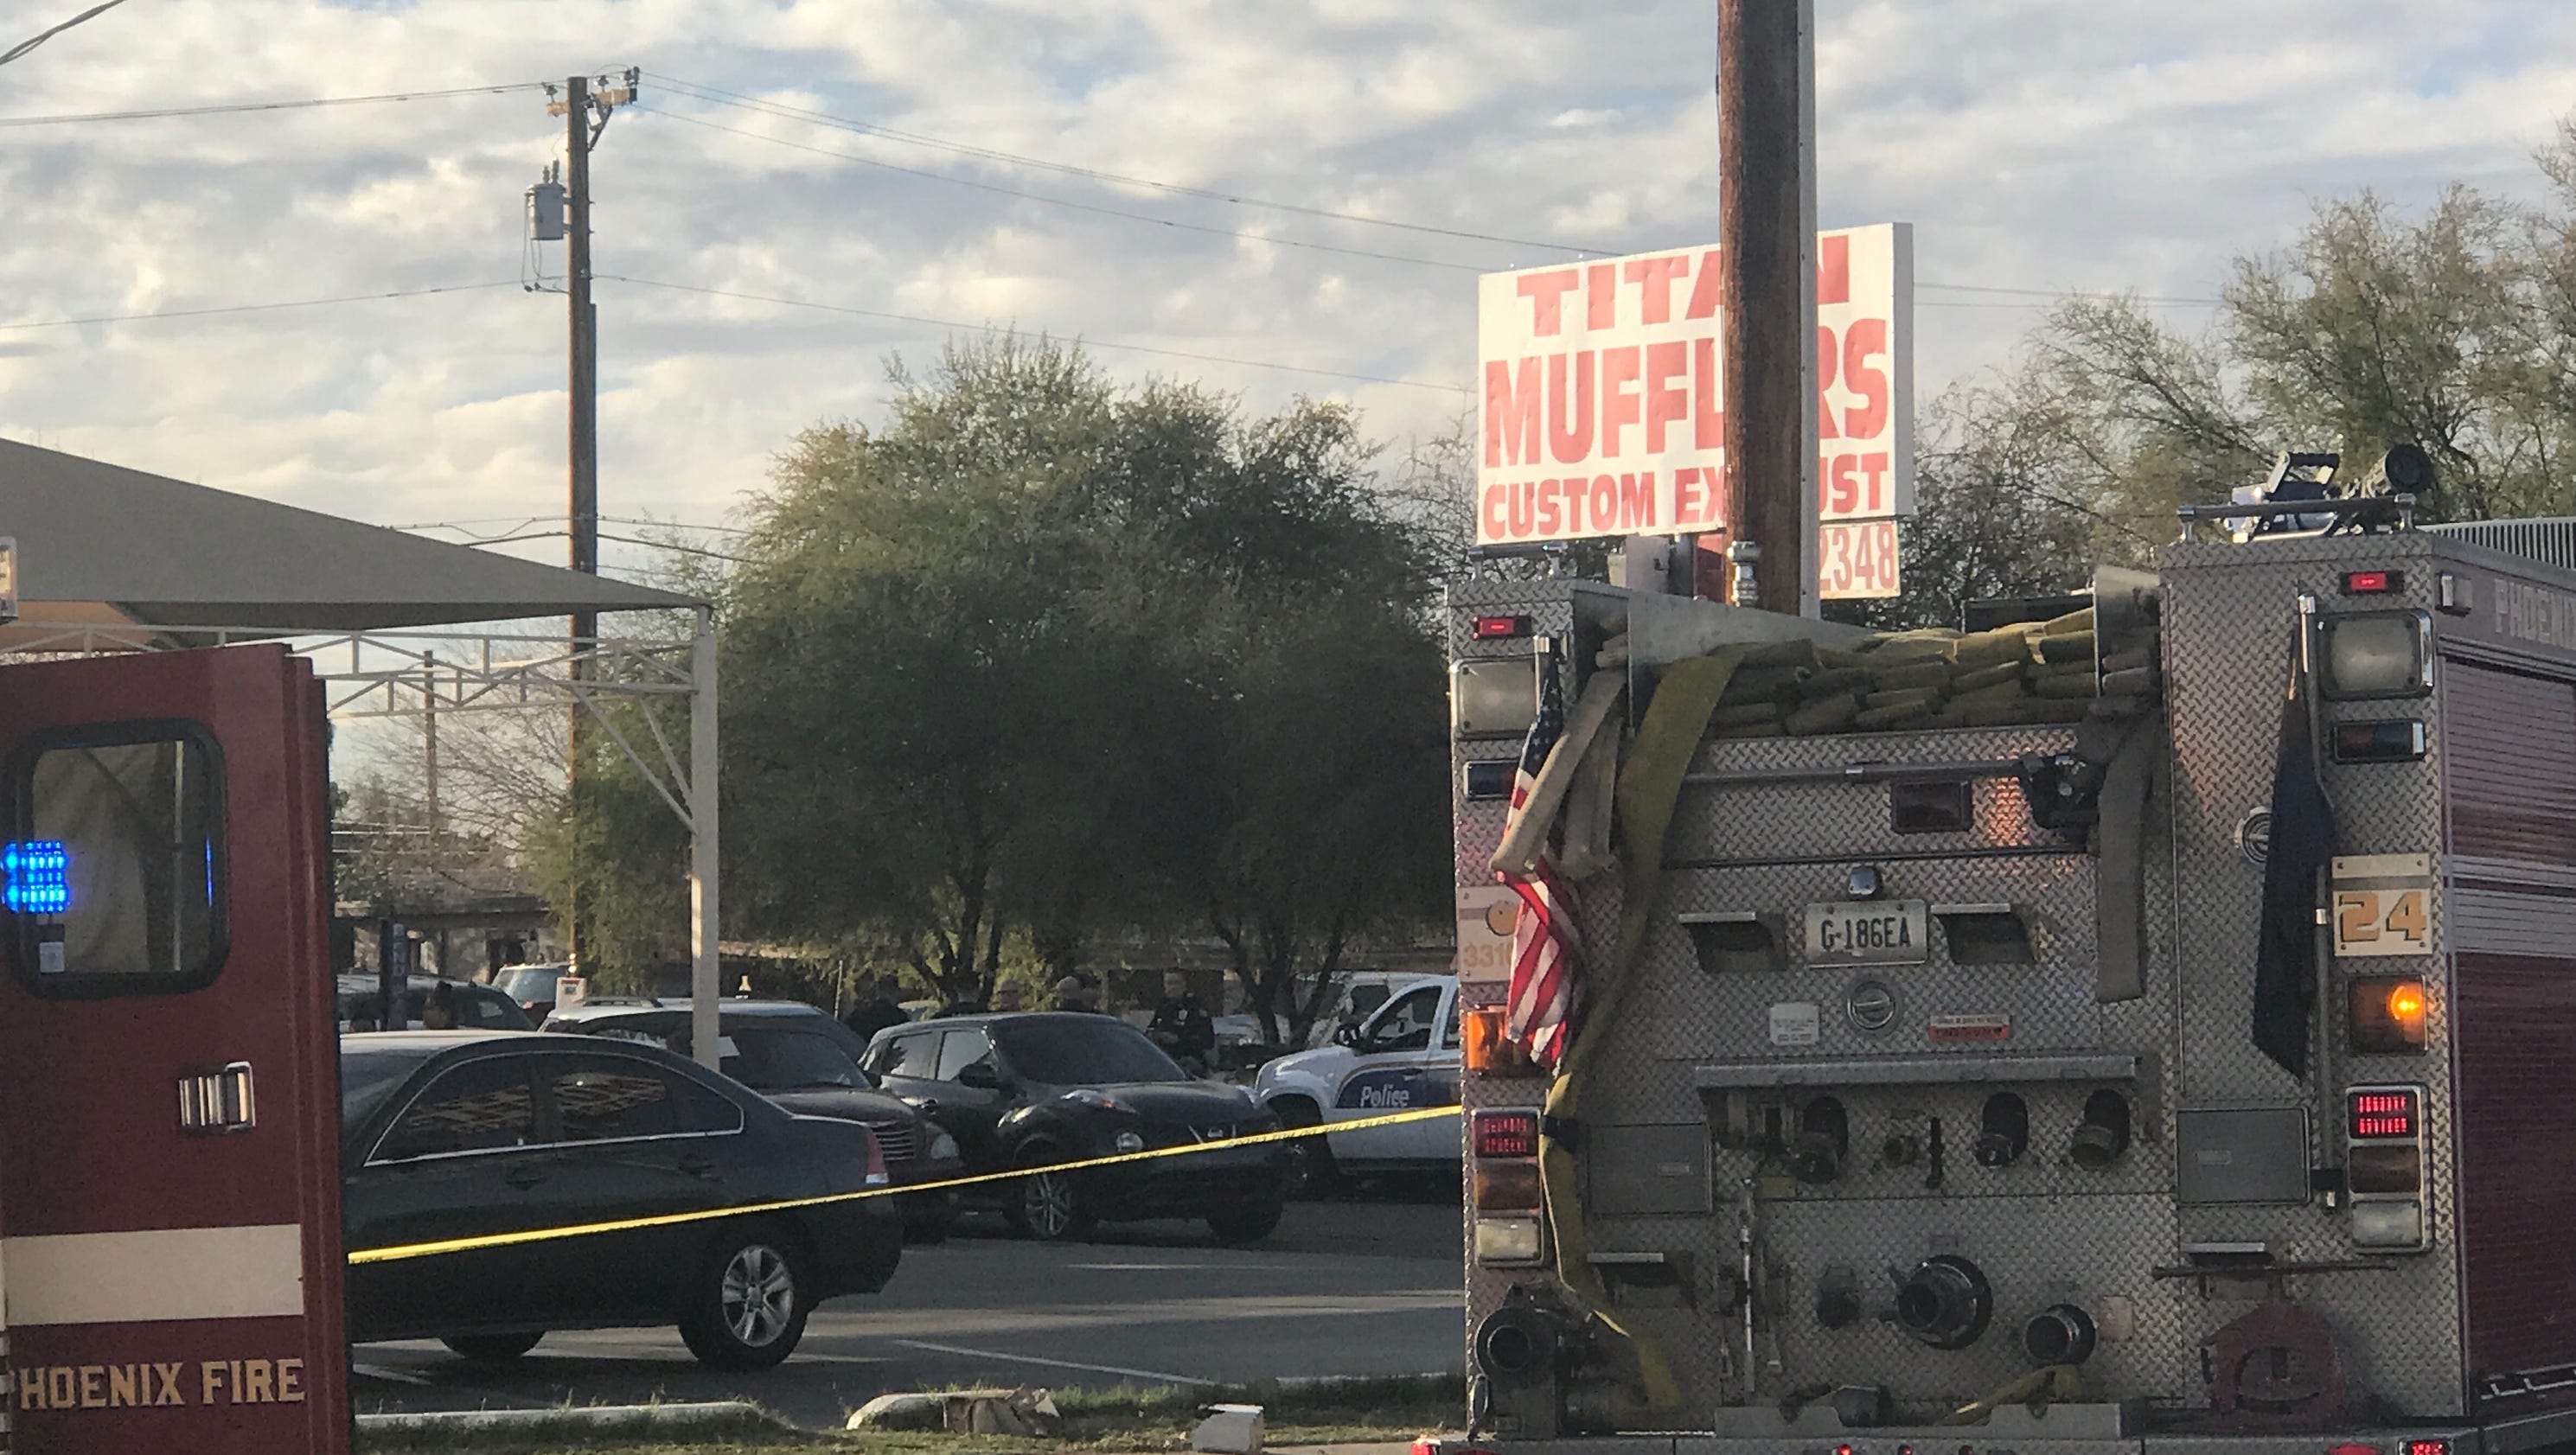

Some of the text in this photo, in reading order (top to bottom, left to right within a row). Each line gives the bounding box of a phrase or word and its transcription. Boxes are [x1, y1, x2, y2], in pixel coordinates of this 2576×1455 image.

[1485, 318, 1889, 469] MUFFLS
[1483, 452, 1889, 540] CUSTOM EXST
[2338, 891, 2427, 942] 24
[1359, 1084, 1410, 1108] Police
[5, 1358, 306, 1411] HOENIX FIRE
